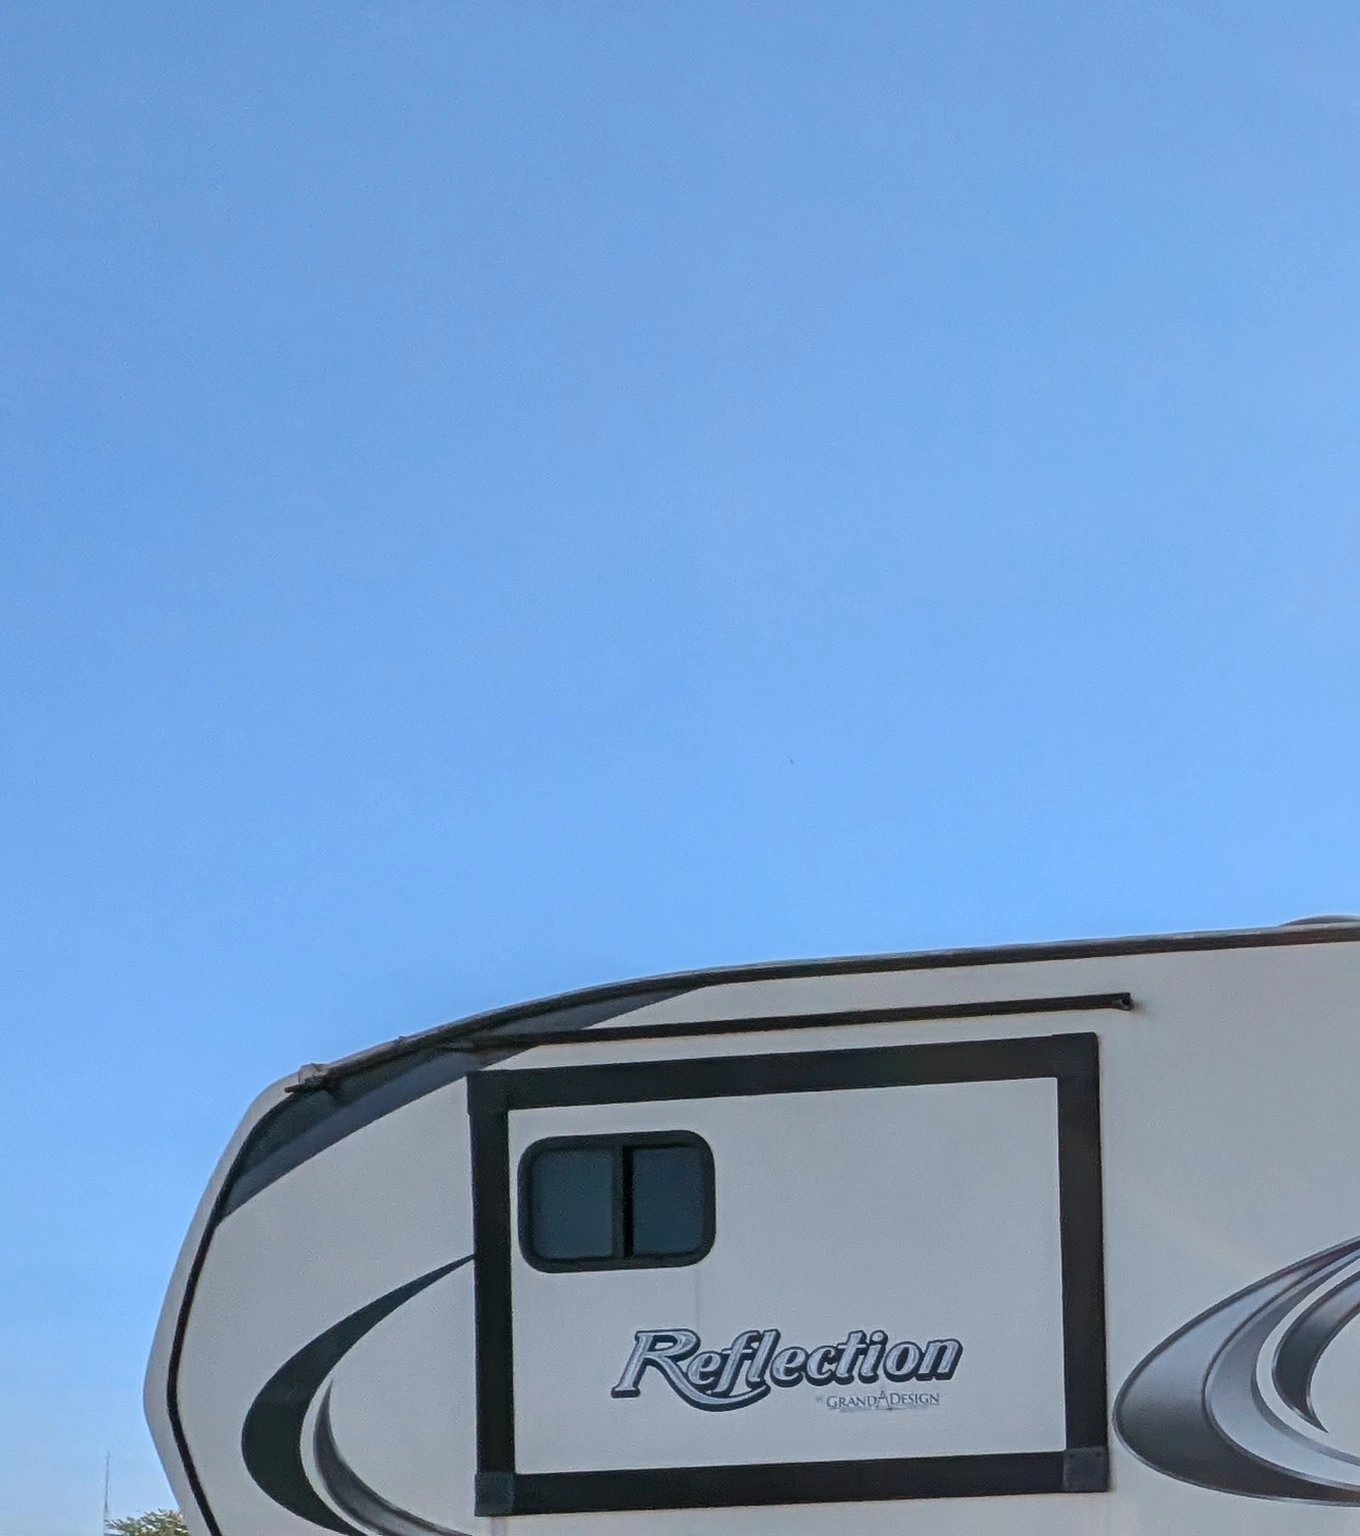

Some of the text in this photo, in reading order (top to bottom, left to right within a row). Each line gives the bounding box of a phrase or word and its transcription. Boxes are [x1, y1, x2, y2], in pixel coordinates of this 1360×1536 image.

[611, 1329, 963, 1412] Reflection
[826, 1395, 877, 1409] GRAND
[890, 1392, 940, 1406] DESIGN
